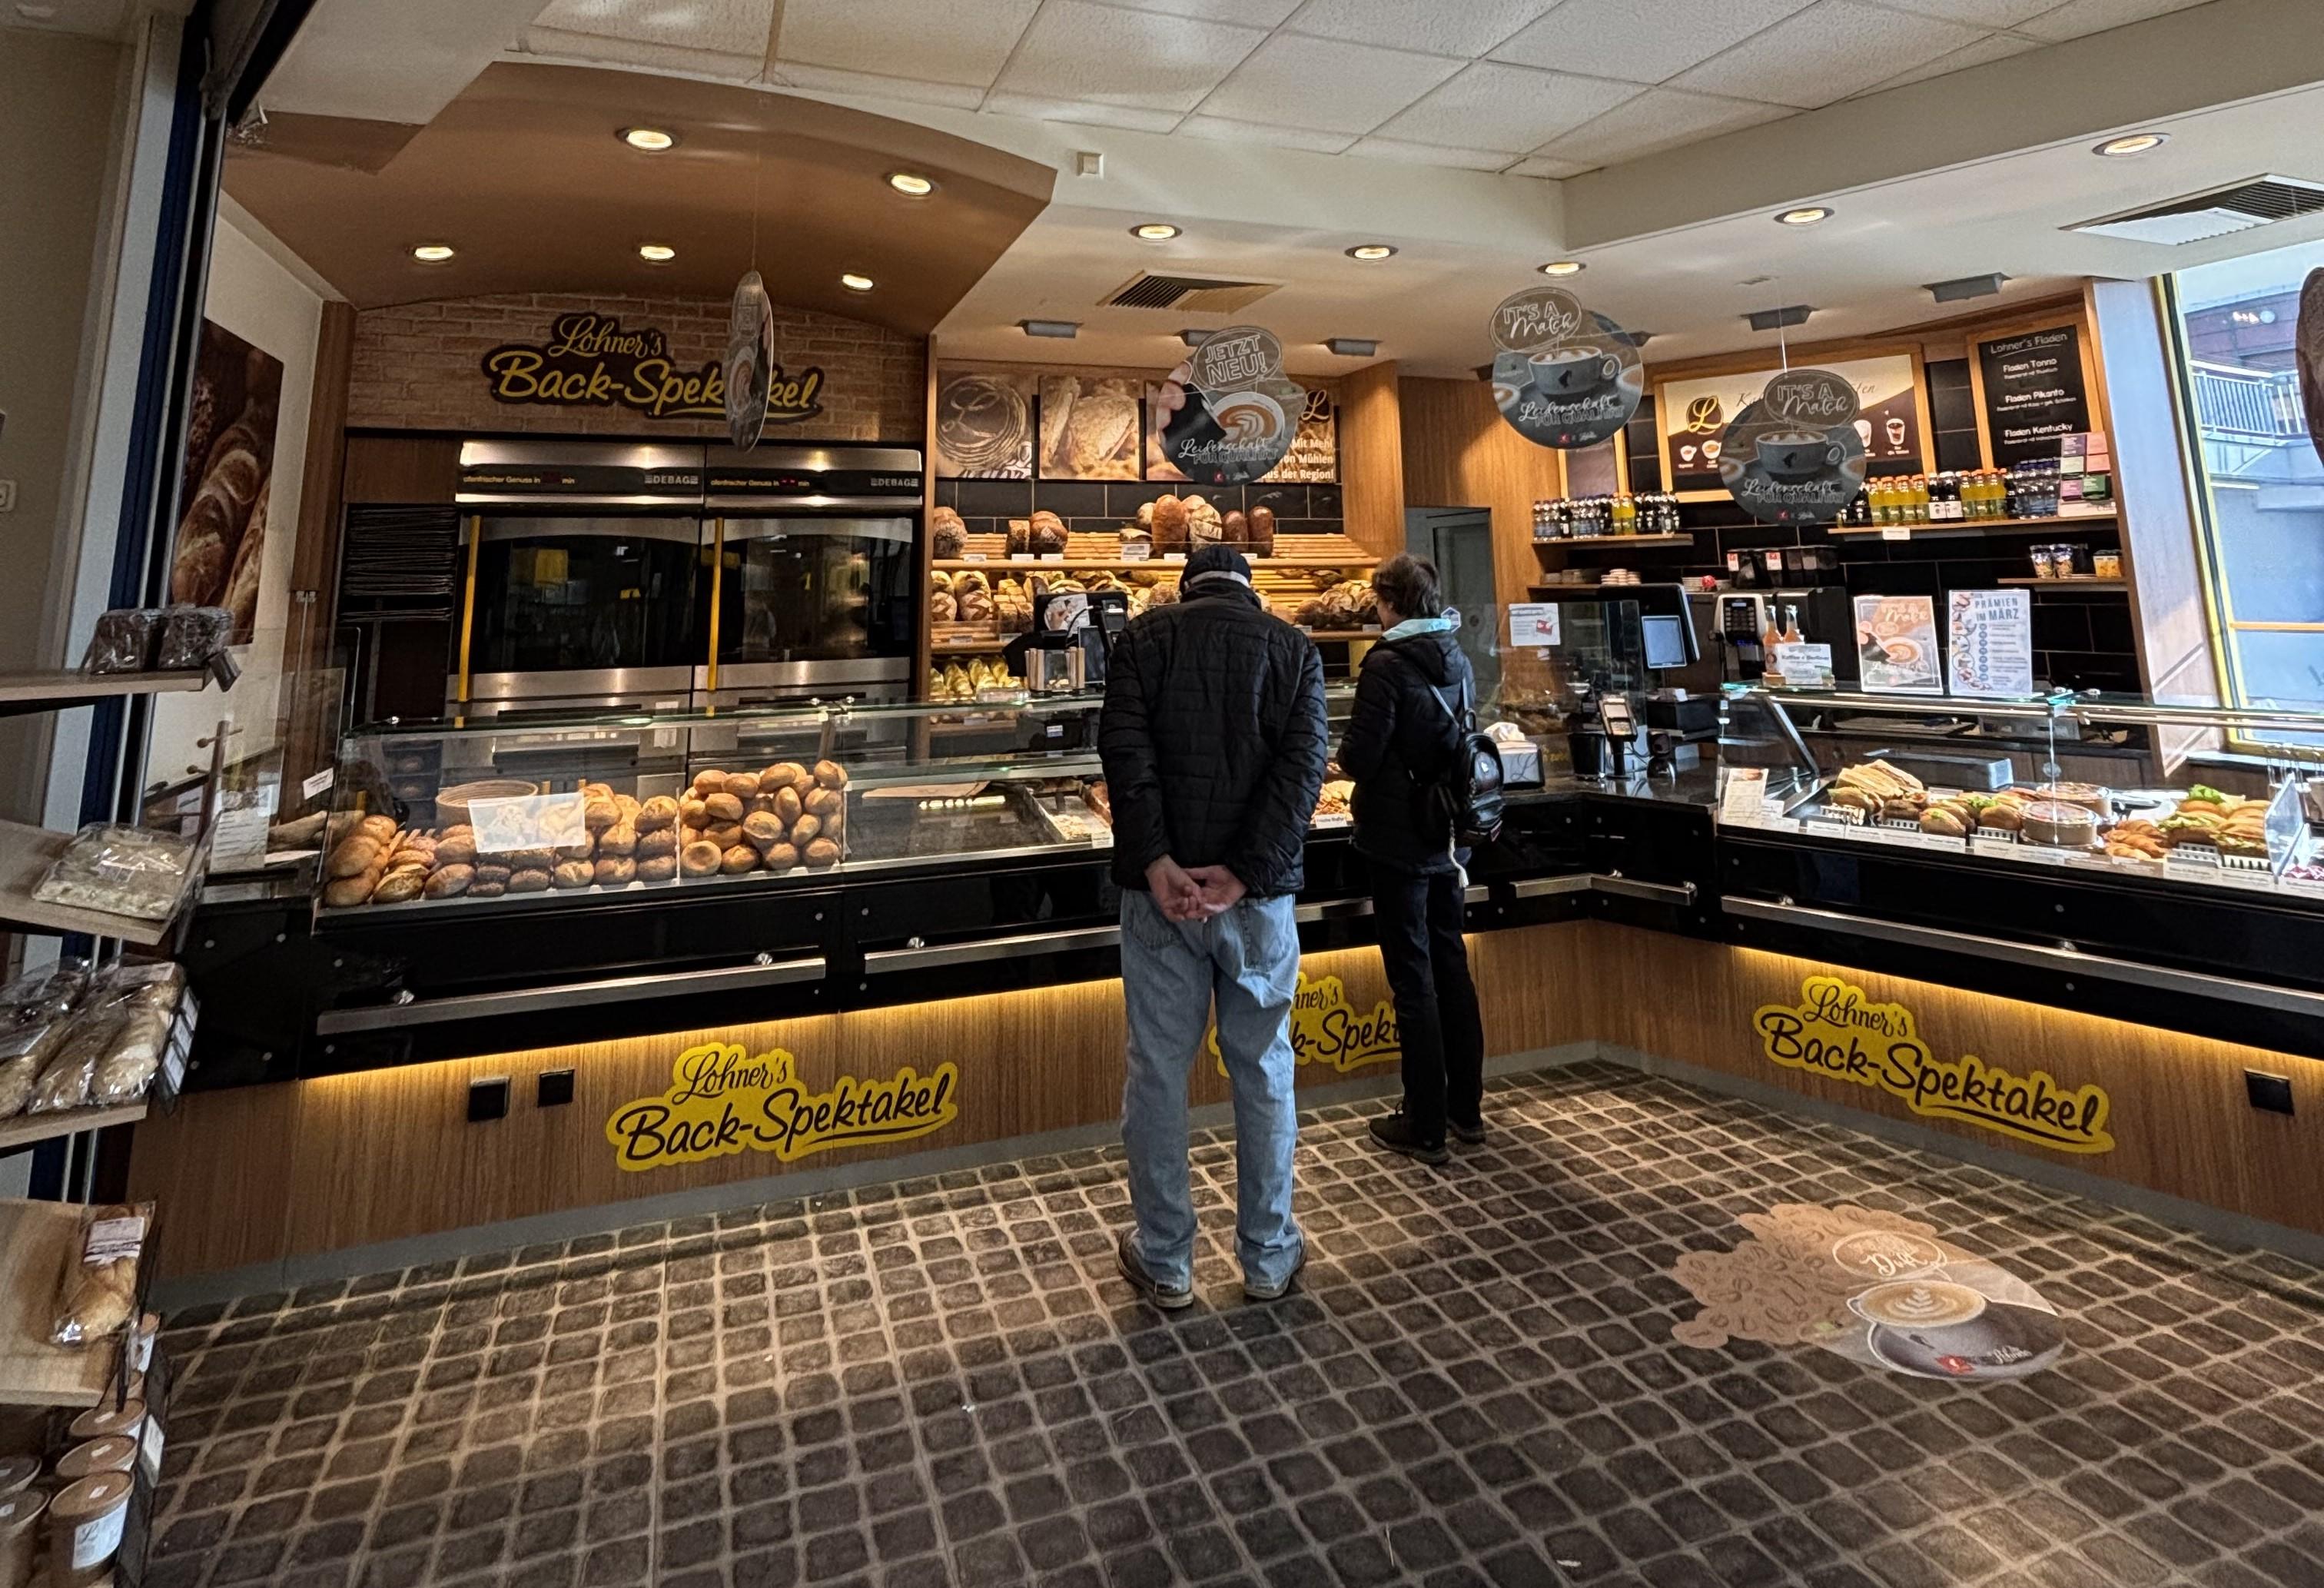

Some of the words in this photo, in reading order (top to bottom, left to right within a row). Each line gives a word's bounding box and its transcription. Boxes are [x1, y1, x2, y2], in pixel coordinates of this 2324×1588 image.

[1503, 303, 1539, 324] IT'S
[1544, 301, 1560, 320] A
[1510, 313, 1575, 338] Match
[548, 316, 662, 358] Lohner's
[2034, 333, 2068, 346] Fladen
[1205, 334, 1261, 363] JETZT
[1206, 352, 1268, 385] NEU!
[2003, 363, 2030, 372] Fladen
[2030, 357, 2057, 368] Tonno
[490, 350, 818, 416] Back-Spekkel
[1777, 384, 1814, 401] IT'S
[1818, 383, 1834, 400] A
[1783, 395, 1848, 416] Match
[2004, 394, 2032, 404] Fladen
[2004, 428, 2031, 437] Fladen
[2033, 423, 2073, 434] Kentucky
[1178, 437, 1268, 458] Leidenschaft
[1310, 438, 1333, 448] Mehl
[1298, 453, 1334, 464] Mühlen
[652, 475, 691, 485] DEBAG
[878, 478, 911, 487] DEBAG
[1281, 469, 1298, 480] der
[1300, 469, 1334, 480] Region!
[1974, 597, 2018, 609] PRÄMIEN
[1988, 608, 2020, 621] MÄRZ
[1803, 983, 1908, 1038] Lohner's
[672, 1051, 788, 1105] Lohner's
[1760, 1012, 2100, 1136] Back-Spektakel
[616, 1072, 951, 1161] Back-Spektakel
